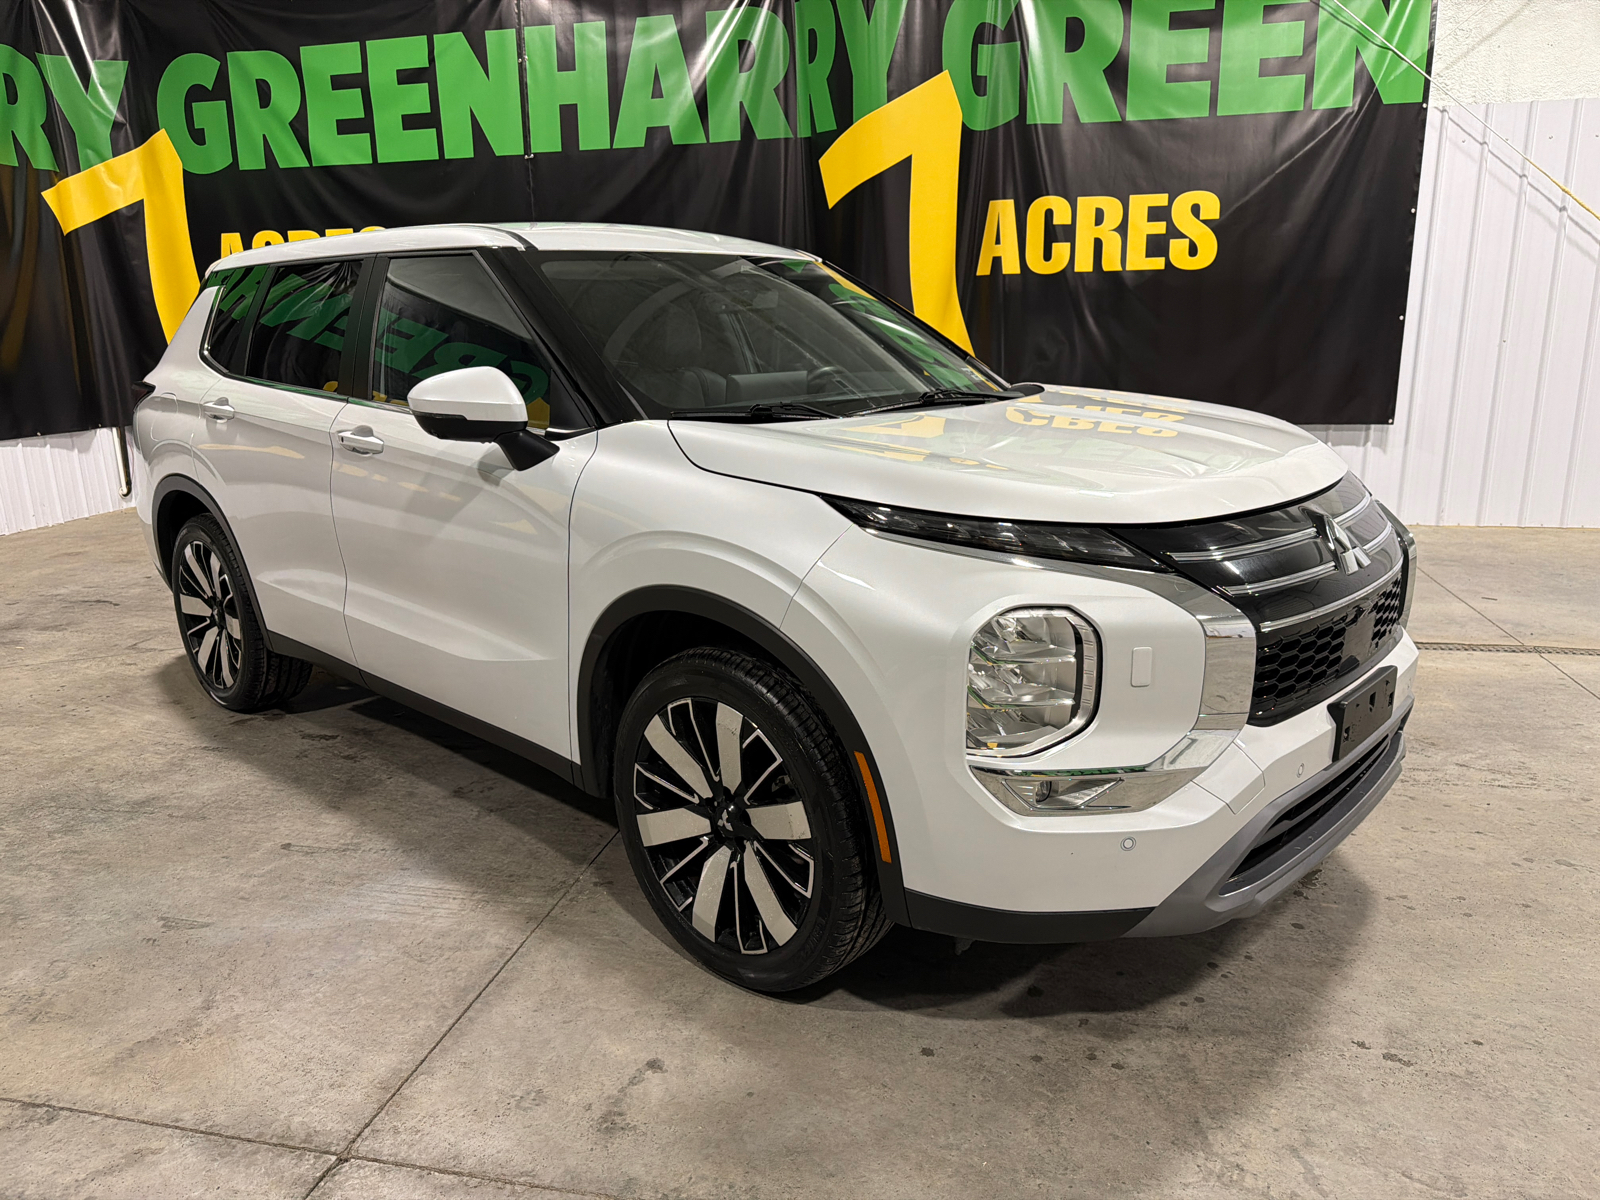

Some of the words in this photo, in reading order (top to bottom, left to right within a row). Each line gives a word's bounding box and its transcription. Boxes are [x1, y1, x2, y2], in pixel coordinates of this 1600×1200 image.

[157, 29, 523, 174] GREEN
[524, 0, 905, 153] HARRY
[942, 0, 1432, 130] GREEN
[41, 128, 200, 345] 7
[819, 69, 976, 358] 7
[976, 190, 1221, 276] ACRES
